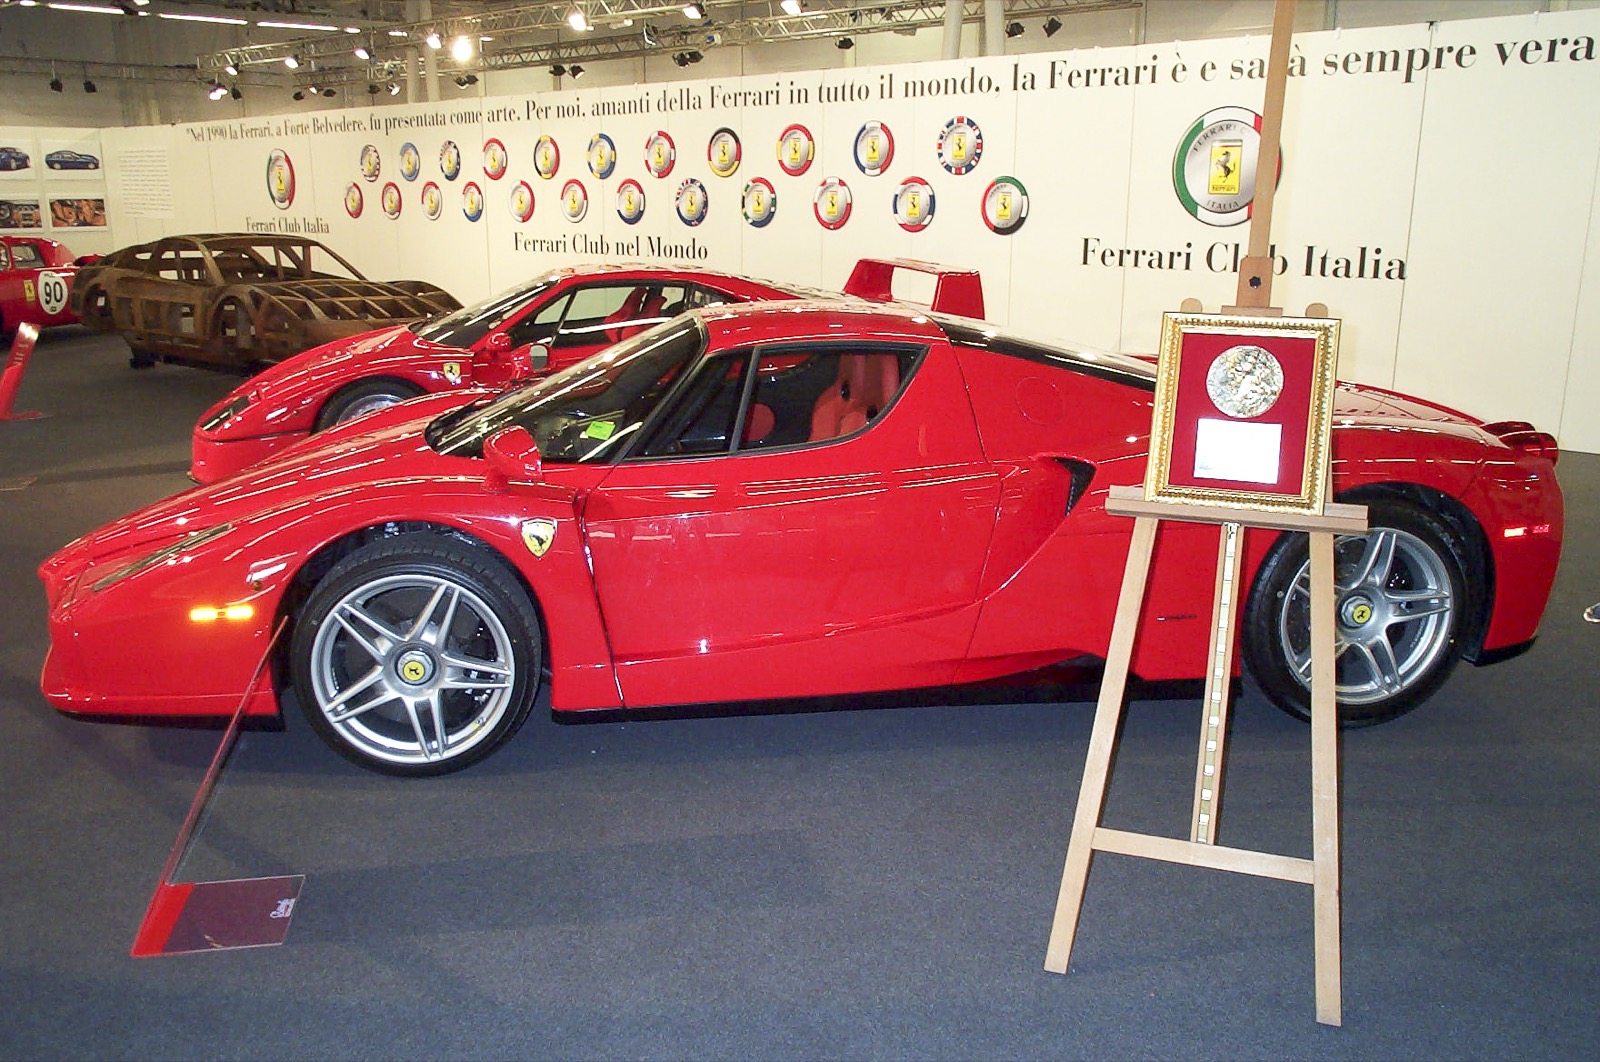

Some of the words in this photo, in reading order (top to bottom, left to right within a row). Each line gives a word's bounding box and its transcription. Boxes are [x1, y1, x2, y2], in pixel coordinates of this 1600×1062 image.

[229, 124, 238, 140] la
[276, 126, 281, 136] a
[284, 119, 309, 136] Forte
[370, 113, 381, 130] fu
[385, 112, 446, 136] presentata
[450, 109, 482, 125] come
[487, 106, 520, 123] arte.
[526, 100, 551, 121] Per
[591, 92, 650, 117] amanti
[657, 88, 702, 112] della
[710, 81, 780, 109] Ferrari
[790, 80, 809, 105] in
[818, 78, 870, 103] tutto
[880, 73, 893, 99] il
[904, 67, 1001, 98] mondo,
[1011, 63, 1036, 91] la
[1048, 54, 1159, 89] Ferrari
[1171, 52, 1187, 83] è
[1200, 60, 1217, 82] e
[1230, 43, 1309, 81] saà
[1323, 44, 1477, 84] sempre
[1495, 35, 1597, 66] vera
[1206, 200, 1240, 211] ITALIA
[246, 217, 276, 232] Ferrari
[279, 217, 301, 233] Club
[303, 217, 330, 233] Italia
[513, 231, 567, 253] Ferrari
[572, 233, 610, 255] Club
[615, 235, 640, 257] nel
[647, 236, 708, 260] Mondo
[1080, 237, 1193, 271] Ferrari
[1206, 241, 1288, 276] Clb
[1302, 245, 1408, 281] Italia
[44, 281, 63, 305] 90
